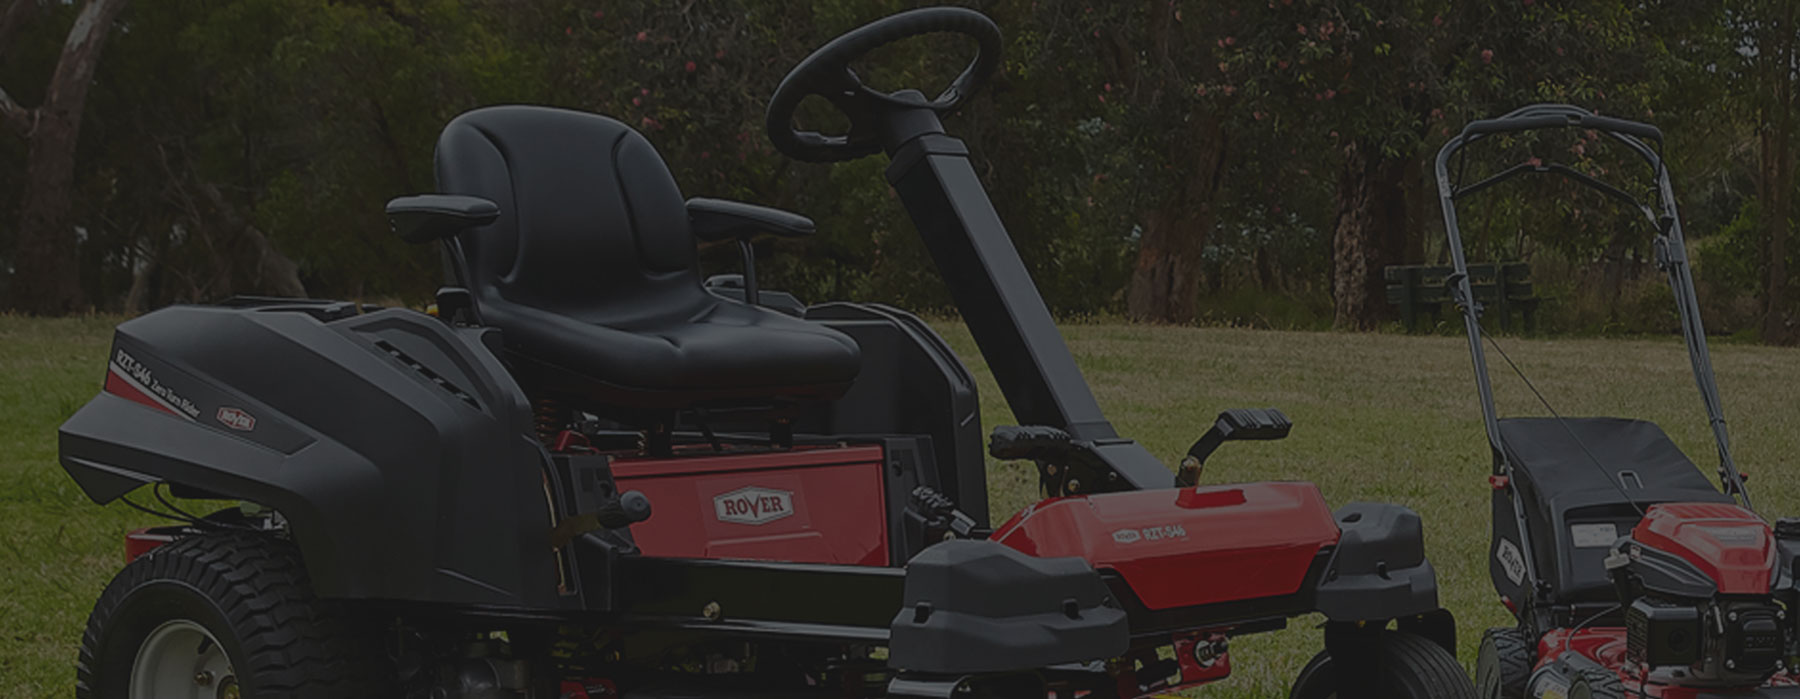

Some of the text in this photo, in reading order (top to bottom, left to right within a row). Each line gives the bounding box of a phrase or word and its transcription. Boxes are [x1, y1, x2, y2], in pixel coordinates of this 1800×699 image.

[150, 378, 167, 397] Zero
[166, 387, 182, 406] Turn
[181, 398, 201, 418] Rider
[222, 410, 251, 427] ROVER
[723, 494, 784, 518] ROVER
[1502, 544, 1522, 578] ROVER
